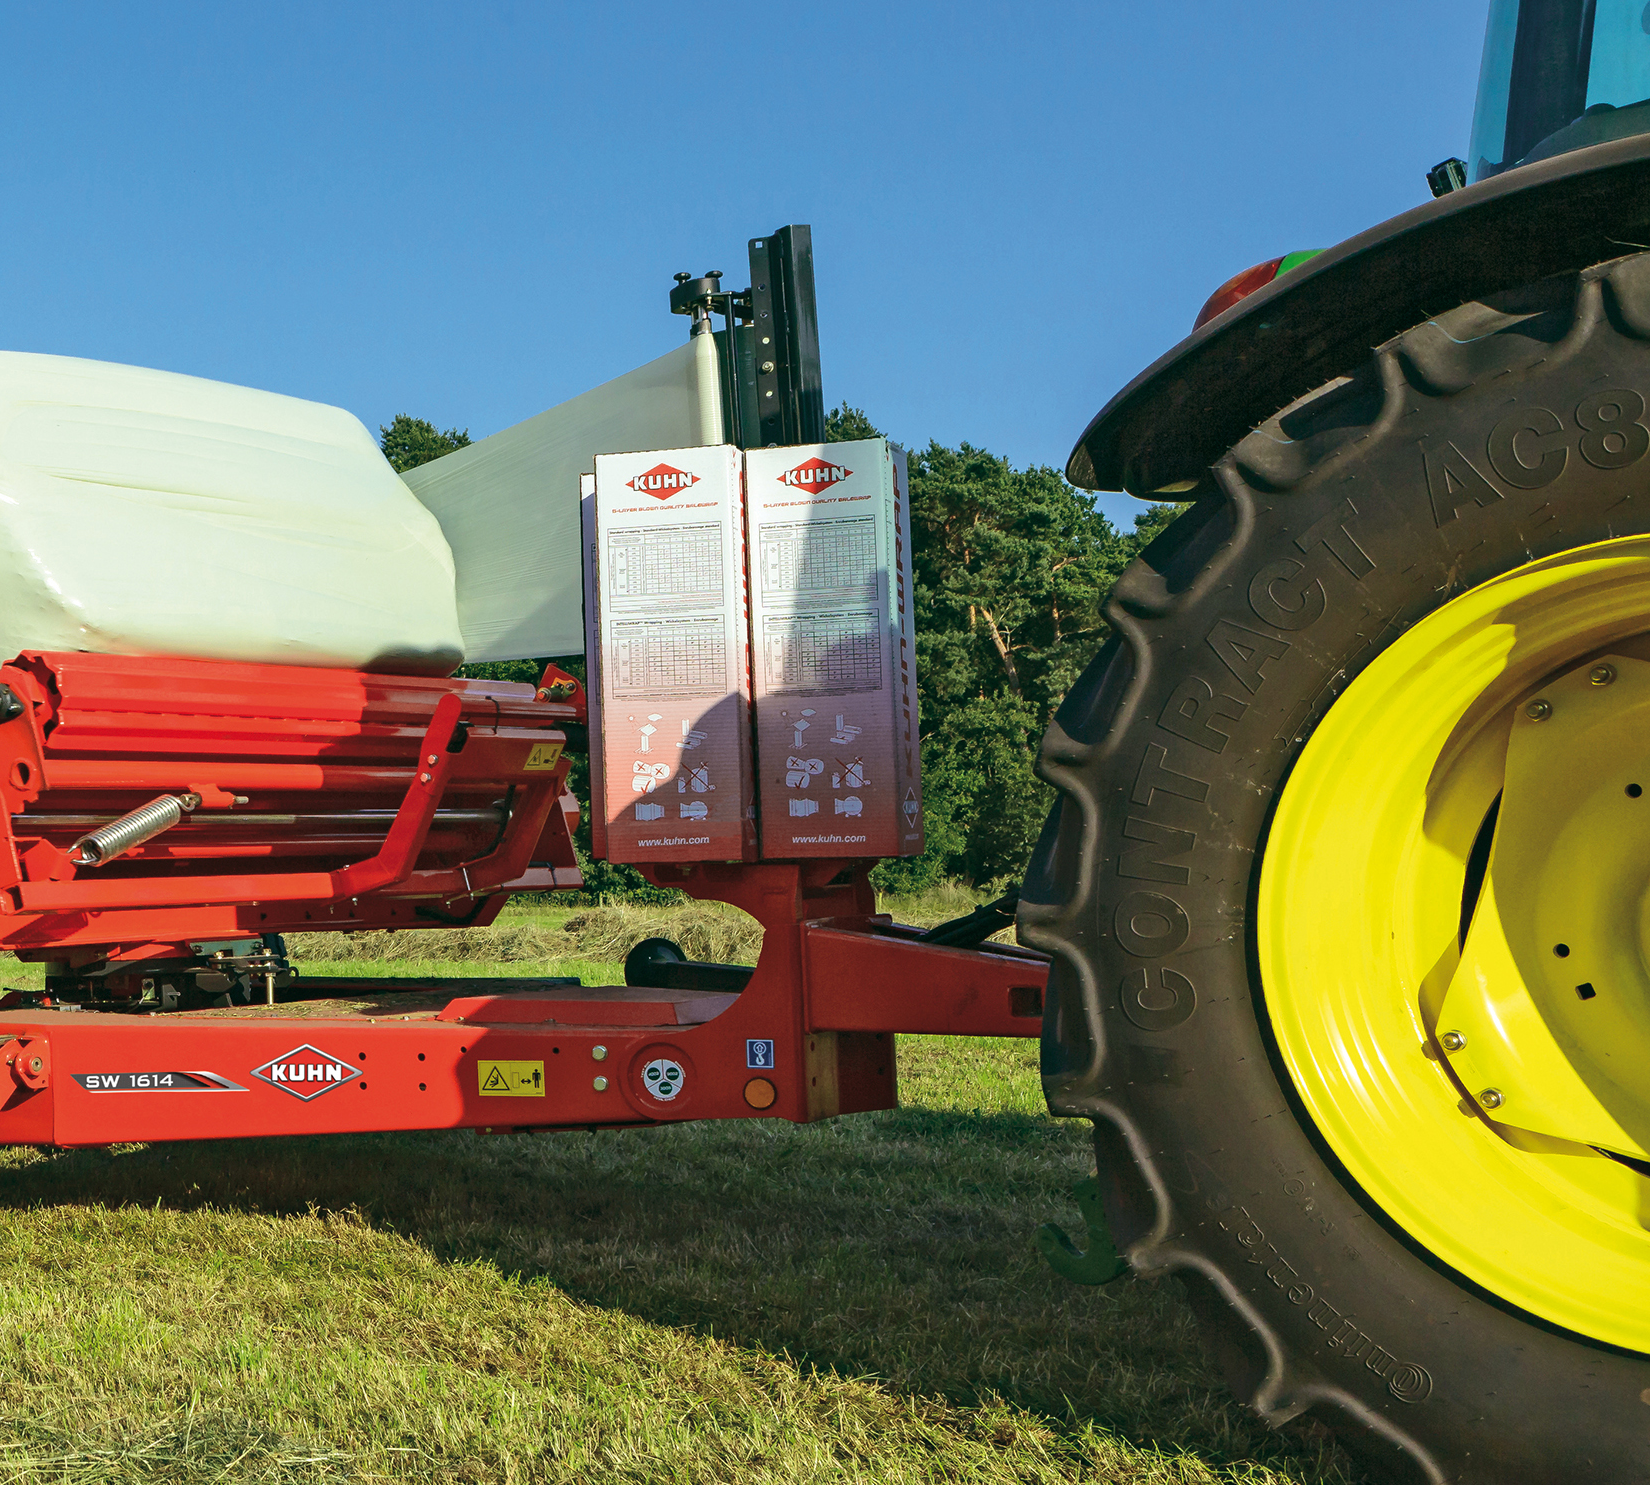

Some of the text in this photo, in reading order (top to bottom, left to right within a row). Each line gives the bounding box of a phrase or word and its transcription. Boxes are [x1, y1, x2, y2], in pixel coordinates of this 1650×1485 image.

[633, 472, 693, 491] KUHN
[784, 466, 846, 486] KUHN
[1114, 388, 1650, 1031] CONTRACT AC8
[638, 835, 710, 847] www.kuhn.com
[792, 834, 866, 844] www.kuhn.com
[85, 1074, 174, 1088] SW 1614
[271, 1064, 342, 1082] KUHN
[1218, 1206, 1433, 1404] Continental
